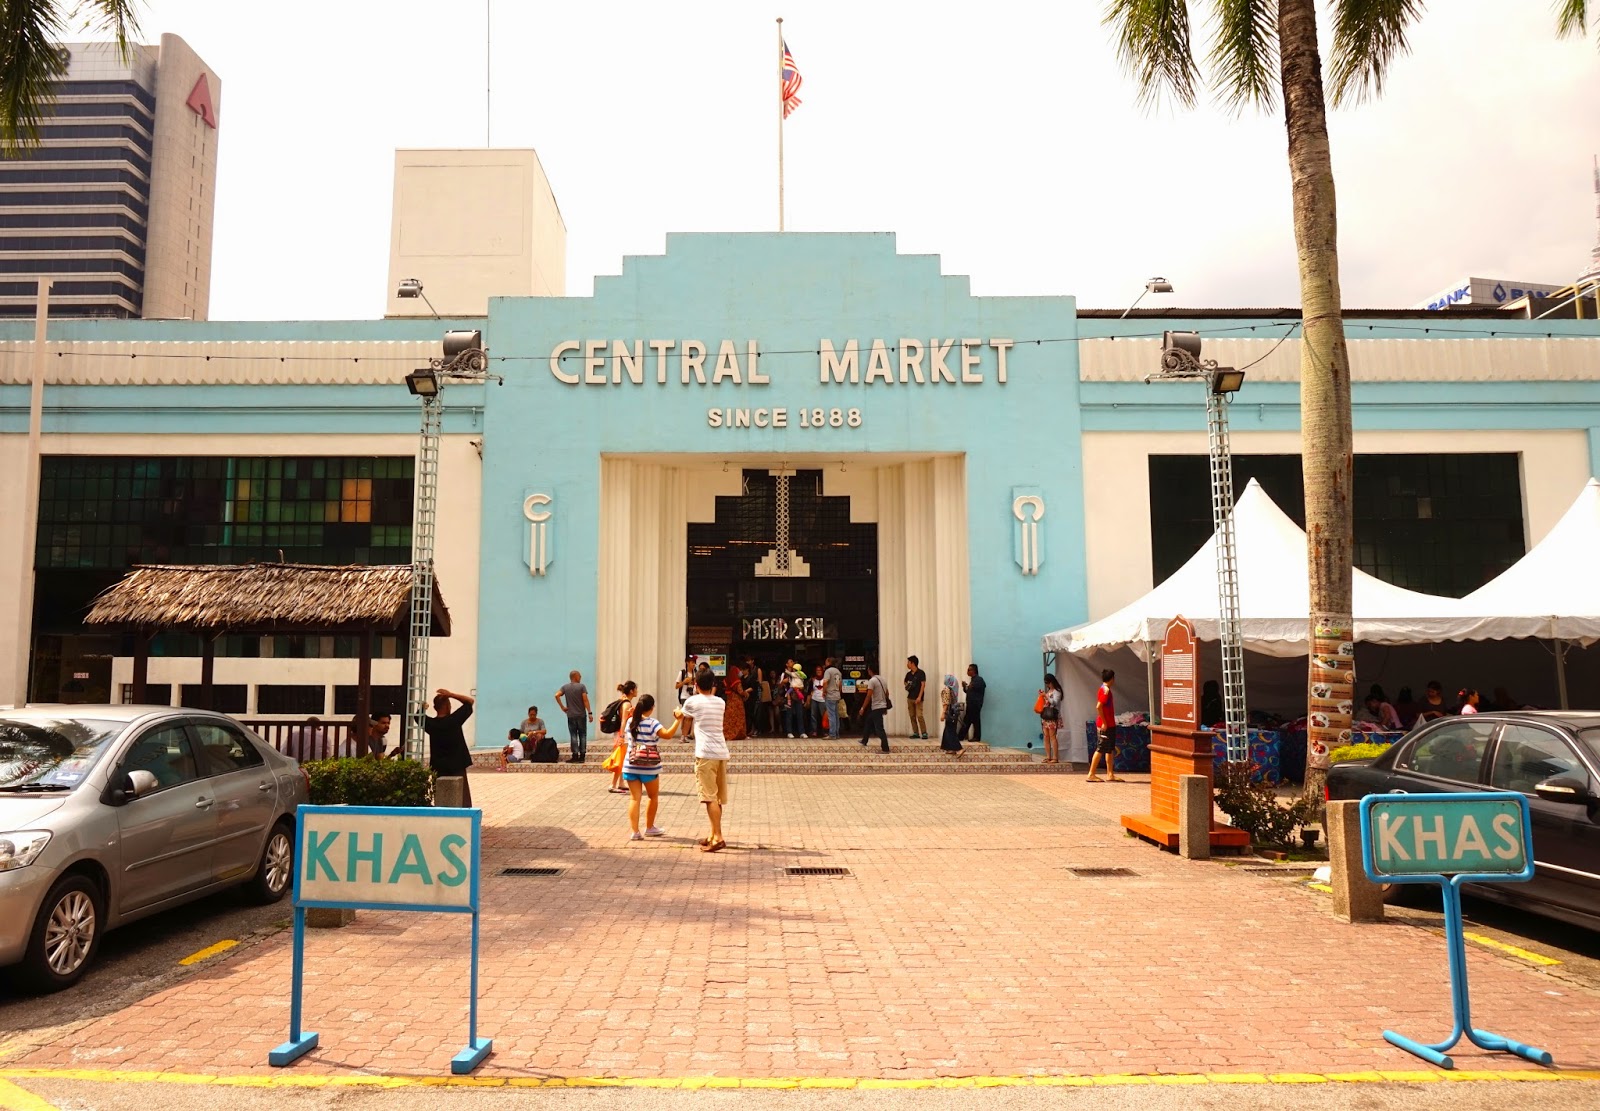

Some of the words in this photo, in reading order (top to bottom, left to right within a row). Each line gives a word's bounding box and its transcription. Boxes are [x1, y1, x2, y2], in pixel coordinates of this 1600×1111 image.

[1510, 288, 1550, 300] BAN
[549, 339, 770, 385] CENTRAL
[819, 338, 1014, 385] MARKET
[707, 408, 787, 428] SINCE
[799, 407, 863, 428] 1888
[742, 618, 788, 640] PASAR
[795, 617, 824, 639] SENI
[1378, 813, 1521, 861] KHAS
[306, 830, 468, 887] KHAS
